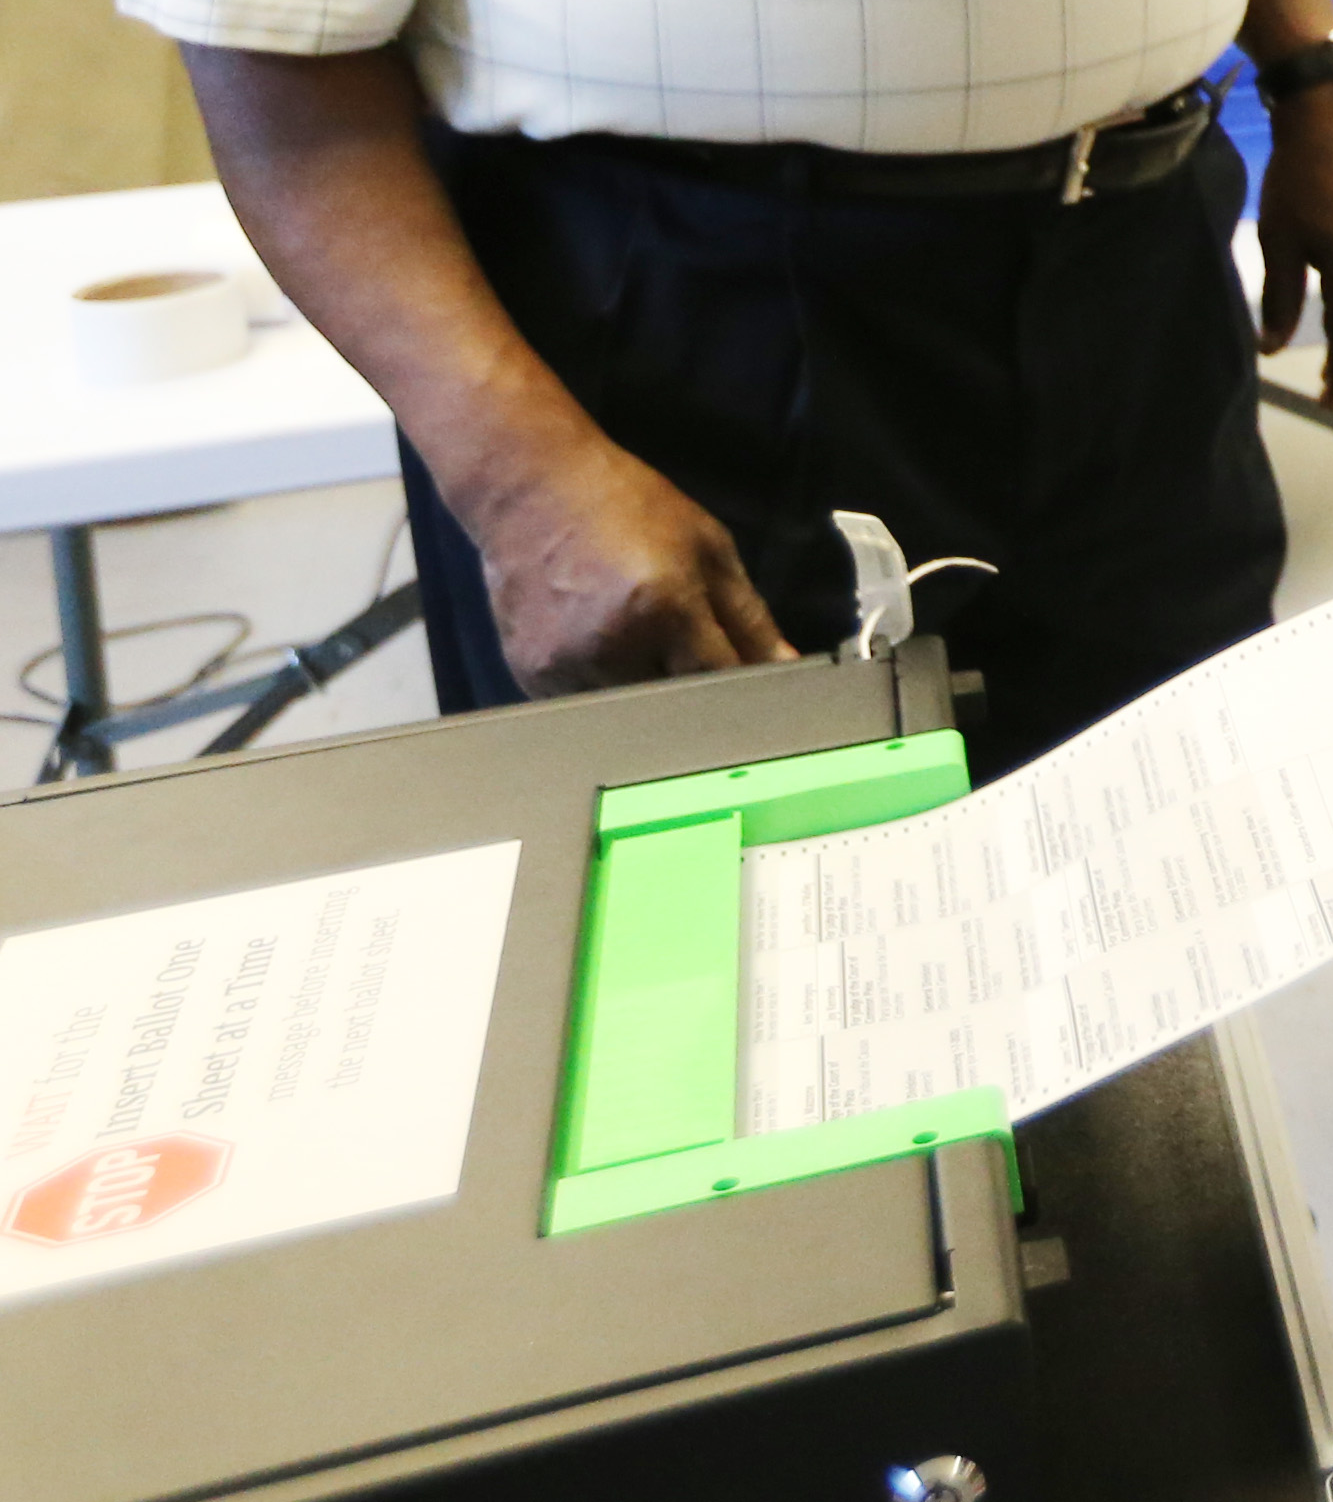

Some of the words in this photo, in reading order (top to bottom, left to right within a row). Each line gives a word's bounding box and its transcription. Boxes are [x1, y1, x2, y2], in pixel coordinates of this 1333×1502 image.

[310, 884, 361, 960] inserting
[156, 936, 207, 984] One
[225, 933, 279, 994] Time
[286, 958, 330, 1020] before
[348, 963, 385, 1011] ballot
[53, 1003, 109, 1046] the
[128, 990, 185, 1061] Ballot
[213, 1012, 255, 1043] at
[226, 994, 259, 1014] a
[343, 1012, 376, 1055] next
[34, 1048, 90, 1085] for
[182, 1048, 242, 1121] Sheet
[267, 1023, 322, 1104] message
[323, 1057, 364, 1091] the
[5, 1090, 73, 1162] WAIT
[95, 1055, 162, 1140] Insert
[72, 1148, 162, 1235] STOP
